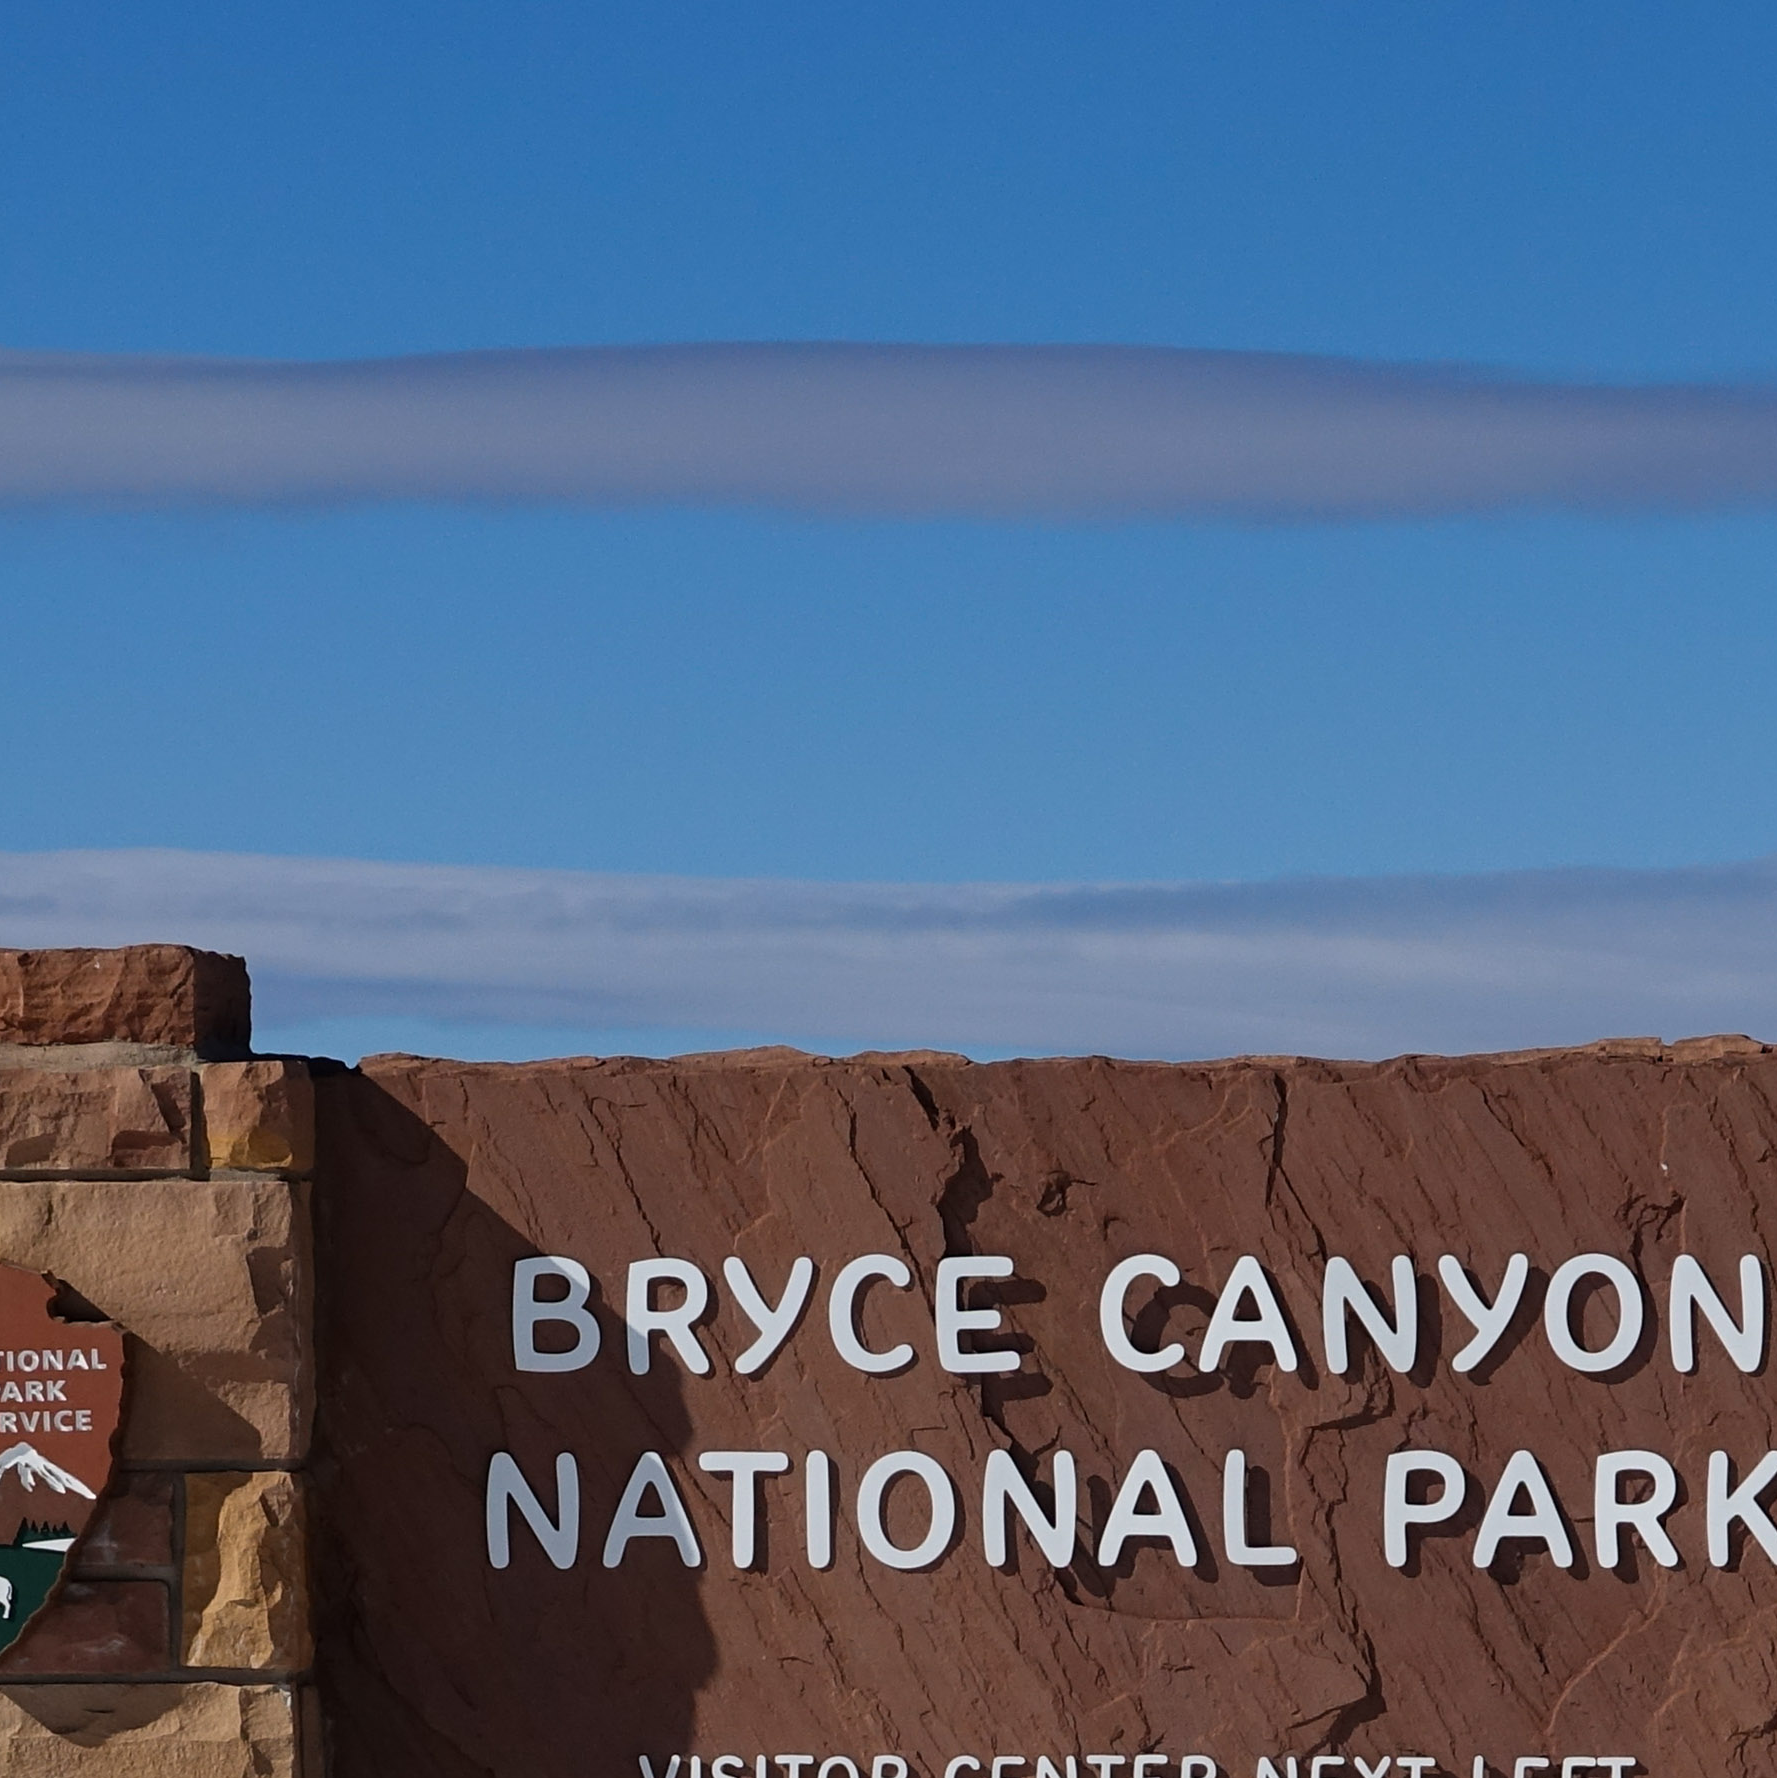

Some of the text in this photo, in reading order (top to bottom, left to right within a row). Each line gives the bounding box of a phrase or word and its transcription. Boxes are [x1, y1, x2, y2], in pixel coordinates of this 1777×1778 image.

[513, 1253, 1763, 1375] BRYCE CANYON
[487, 1449, 1297, 1569] NATIONAL
